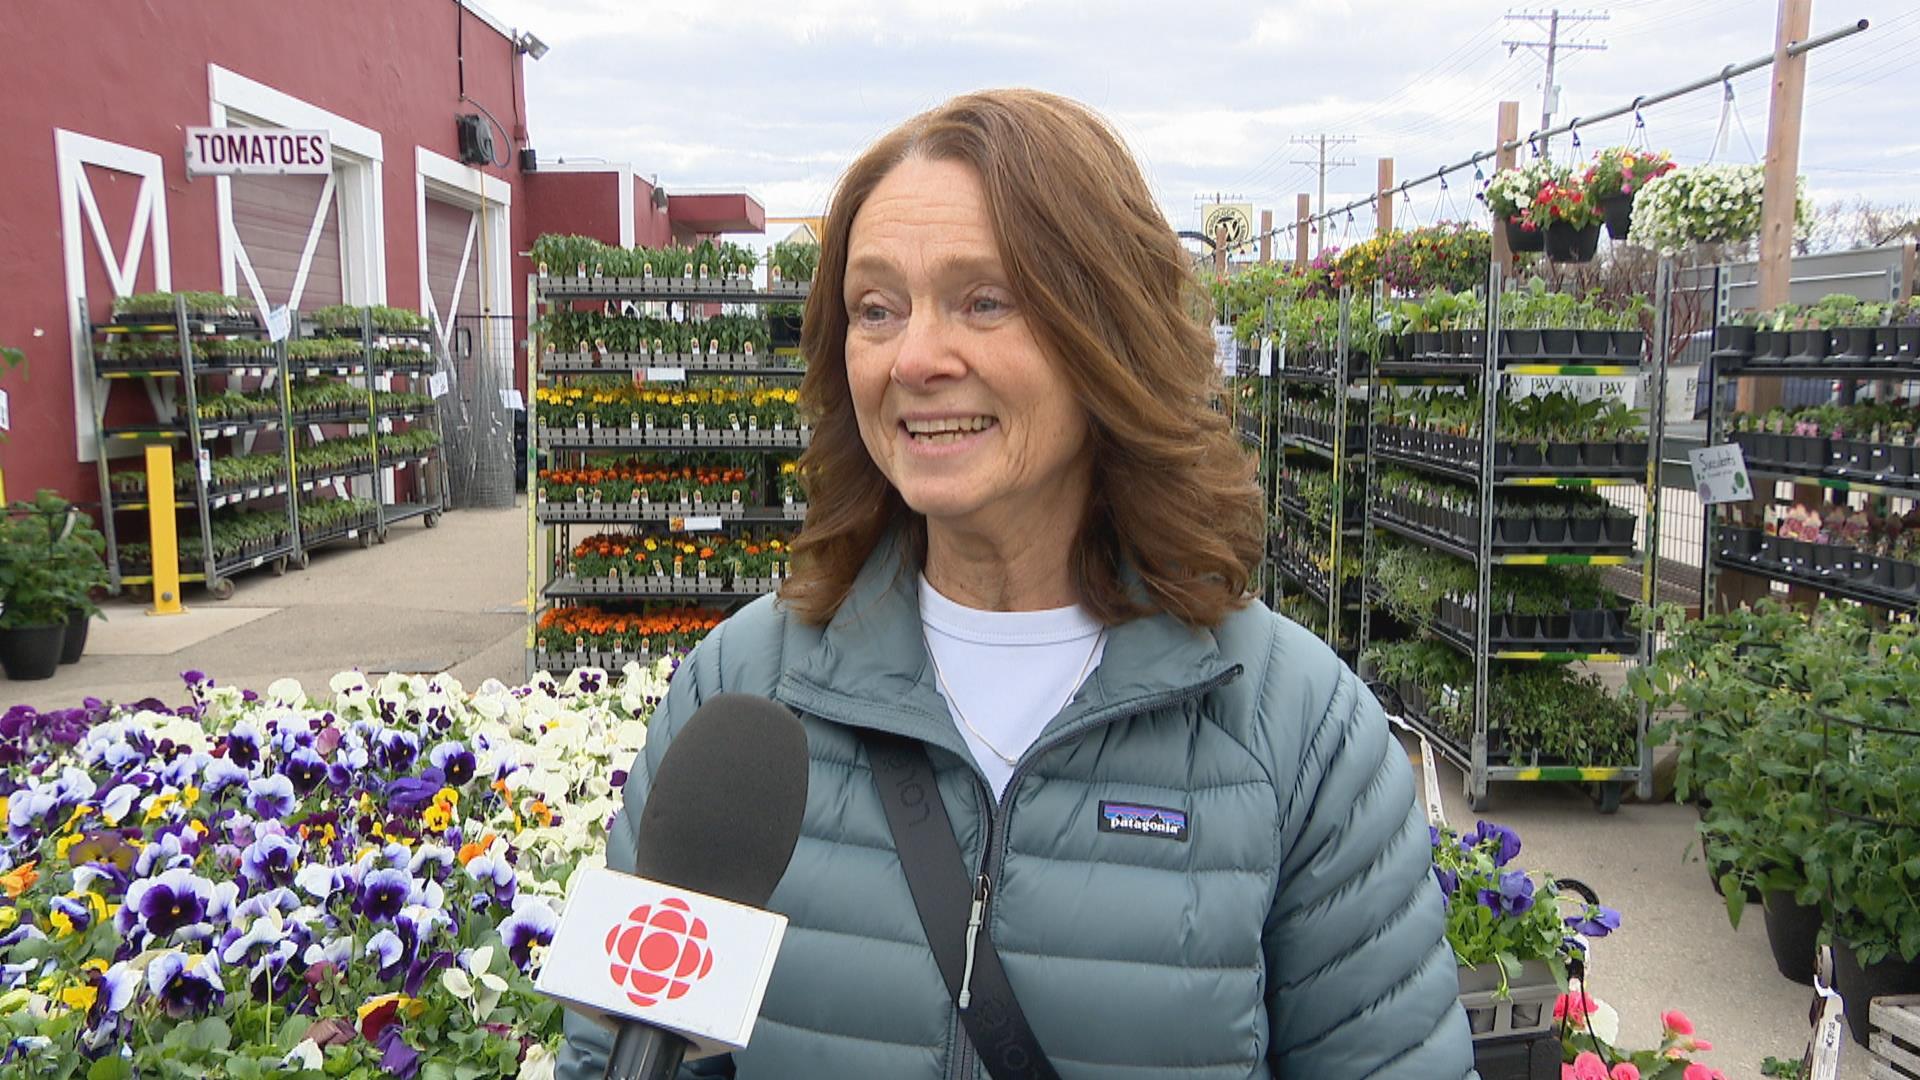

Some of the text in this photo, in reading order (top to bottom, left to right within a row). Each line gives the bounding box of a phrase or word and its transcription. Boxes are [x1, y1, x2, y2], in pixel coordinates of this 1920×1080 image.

[194, 133, 325, 165] TOMATOES
[1599, 381, 1626, 396] PW
[1110, 817, 1180, 835] patagonia
